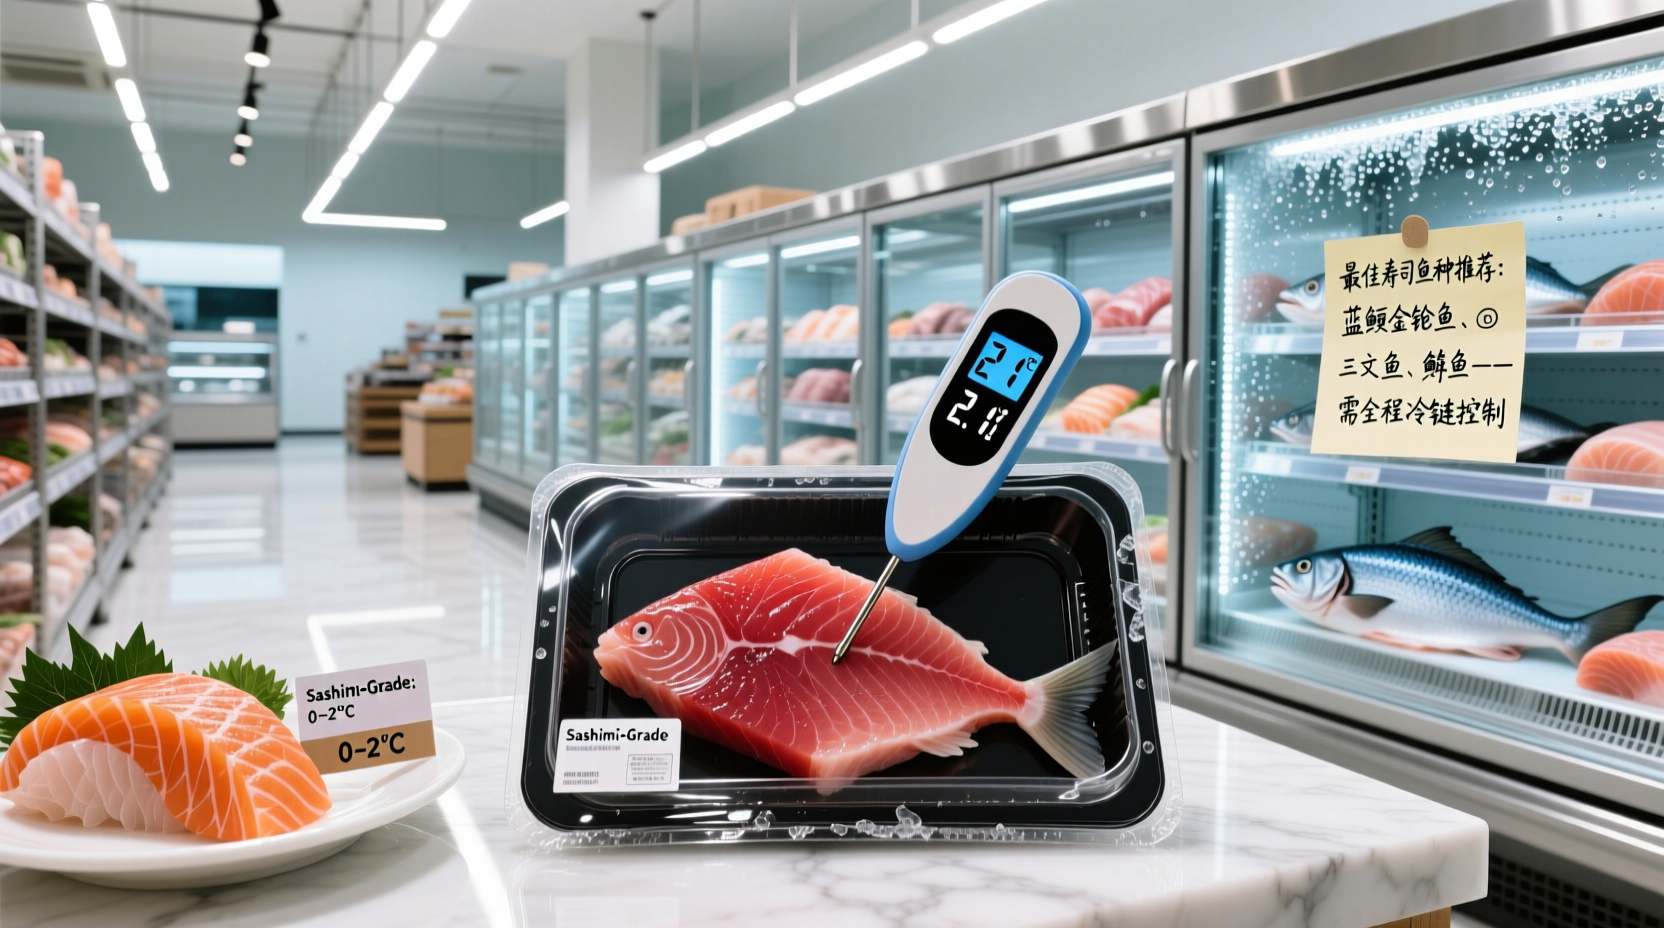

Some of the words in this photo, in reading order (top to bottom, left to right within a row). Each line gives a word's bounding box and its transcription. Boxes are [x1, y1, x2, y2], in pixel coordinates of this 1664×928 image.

[1339, 395, 1506, 430] 需全程冷链控制
[565, 727, 669, 742] Sashimi-Grade
